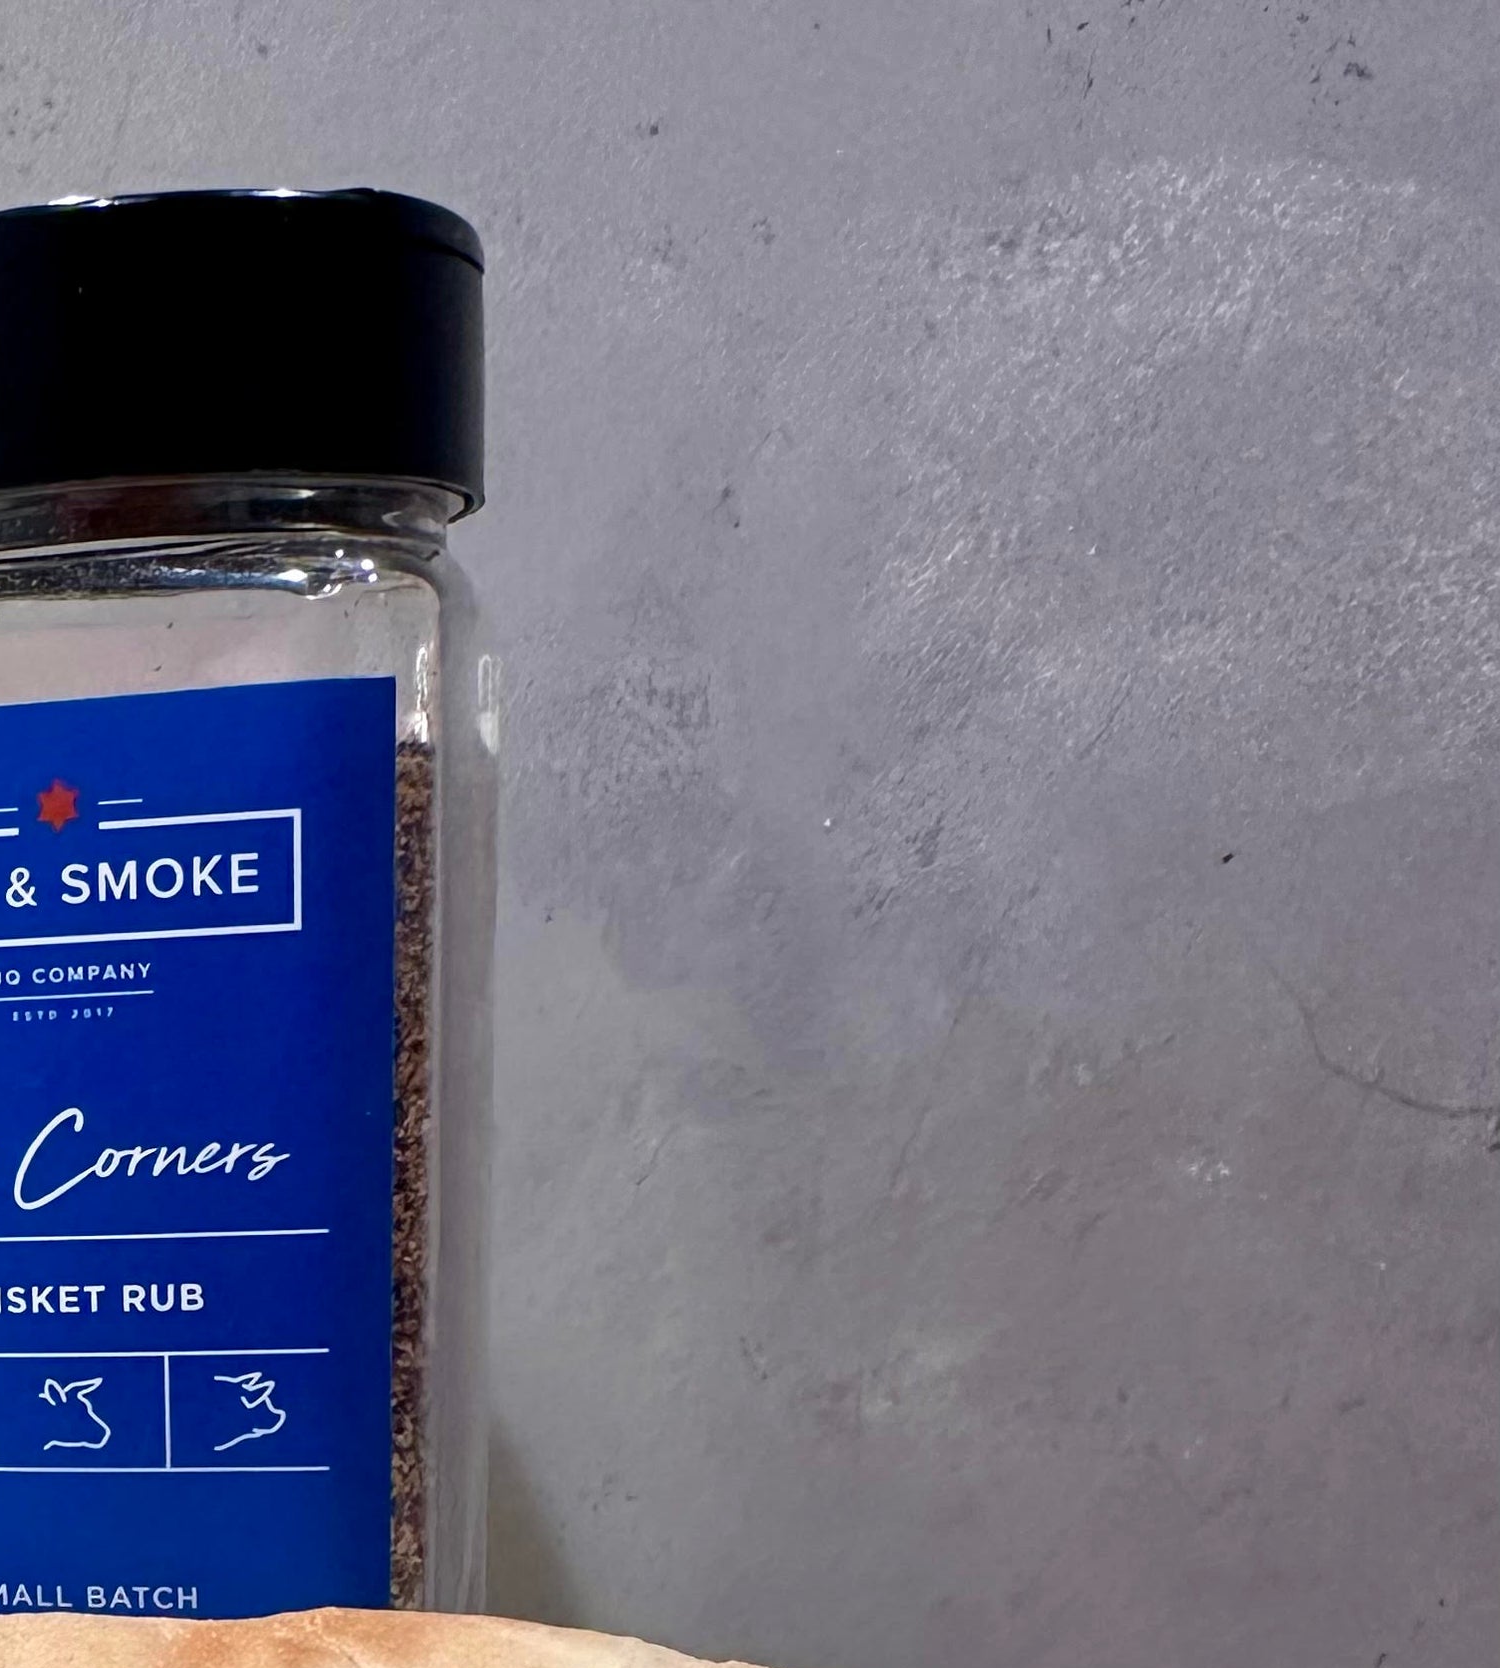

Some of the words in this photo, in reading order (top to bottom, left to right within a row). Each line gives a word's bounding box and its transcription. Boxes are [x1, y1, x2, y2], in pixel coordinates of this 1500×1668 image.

[5, 867, 39, 908] &
[61, 852, 260, 905] SMOKE
[32, 962, 152, 984] COMPANY
[12, 1010, 58, 1022] ESTD
[71, 1006, 114, 1019] 2017
[13, 1107, 291, 1211] Corners
[122, 1283, 205, 1312] RUB
[87, 1585, 198, 1610] BATCH
